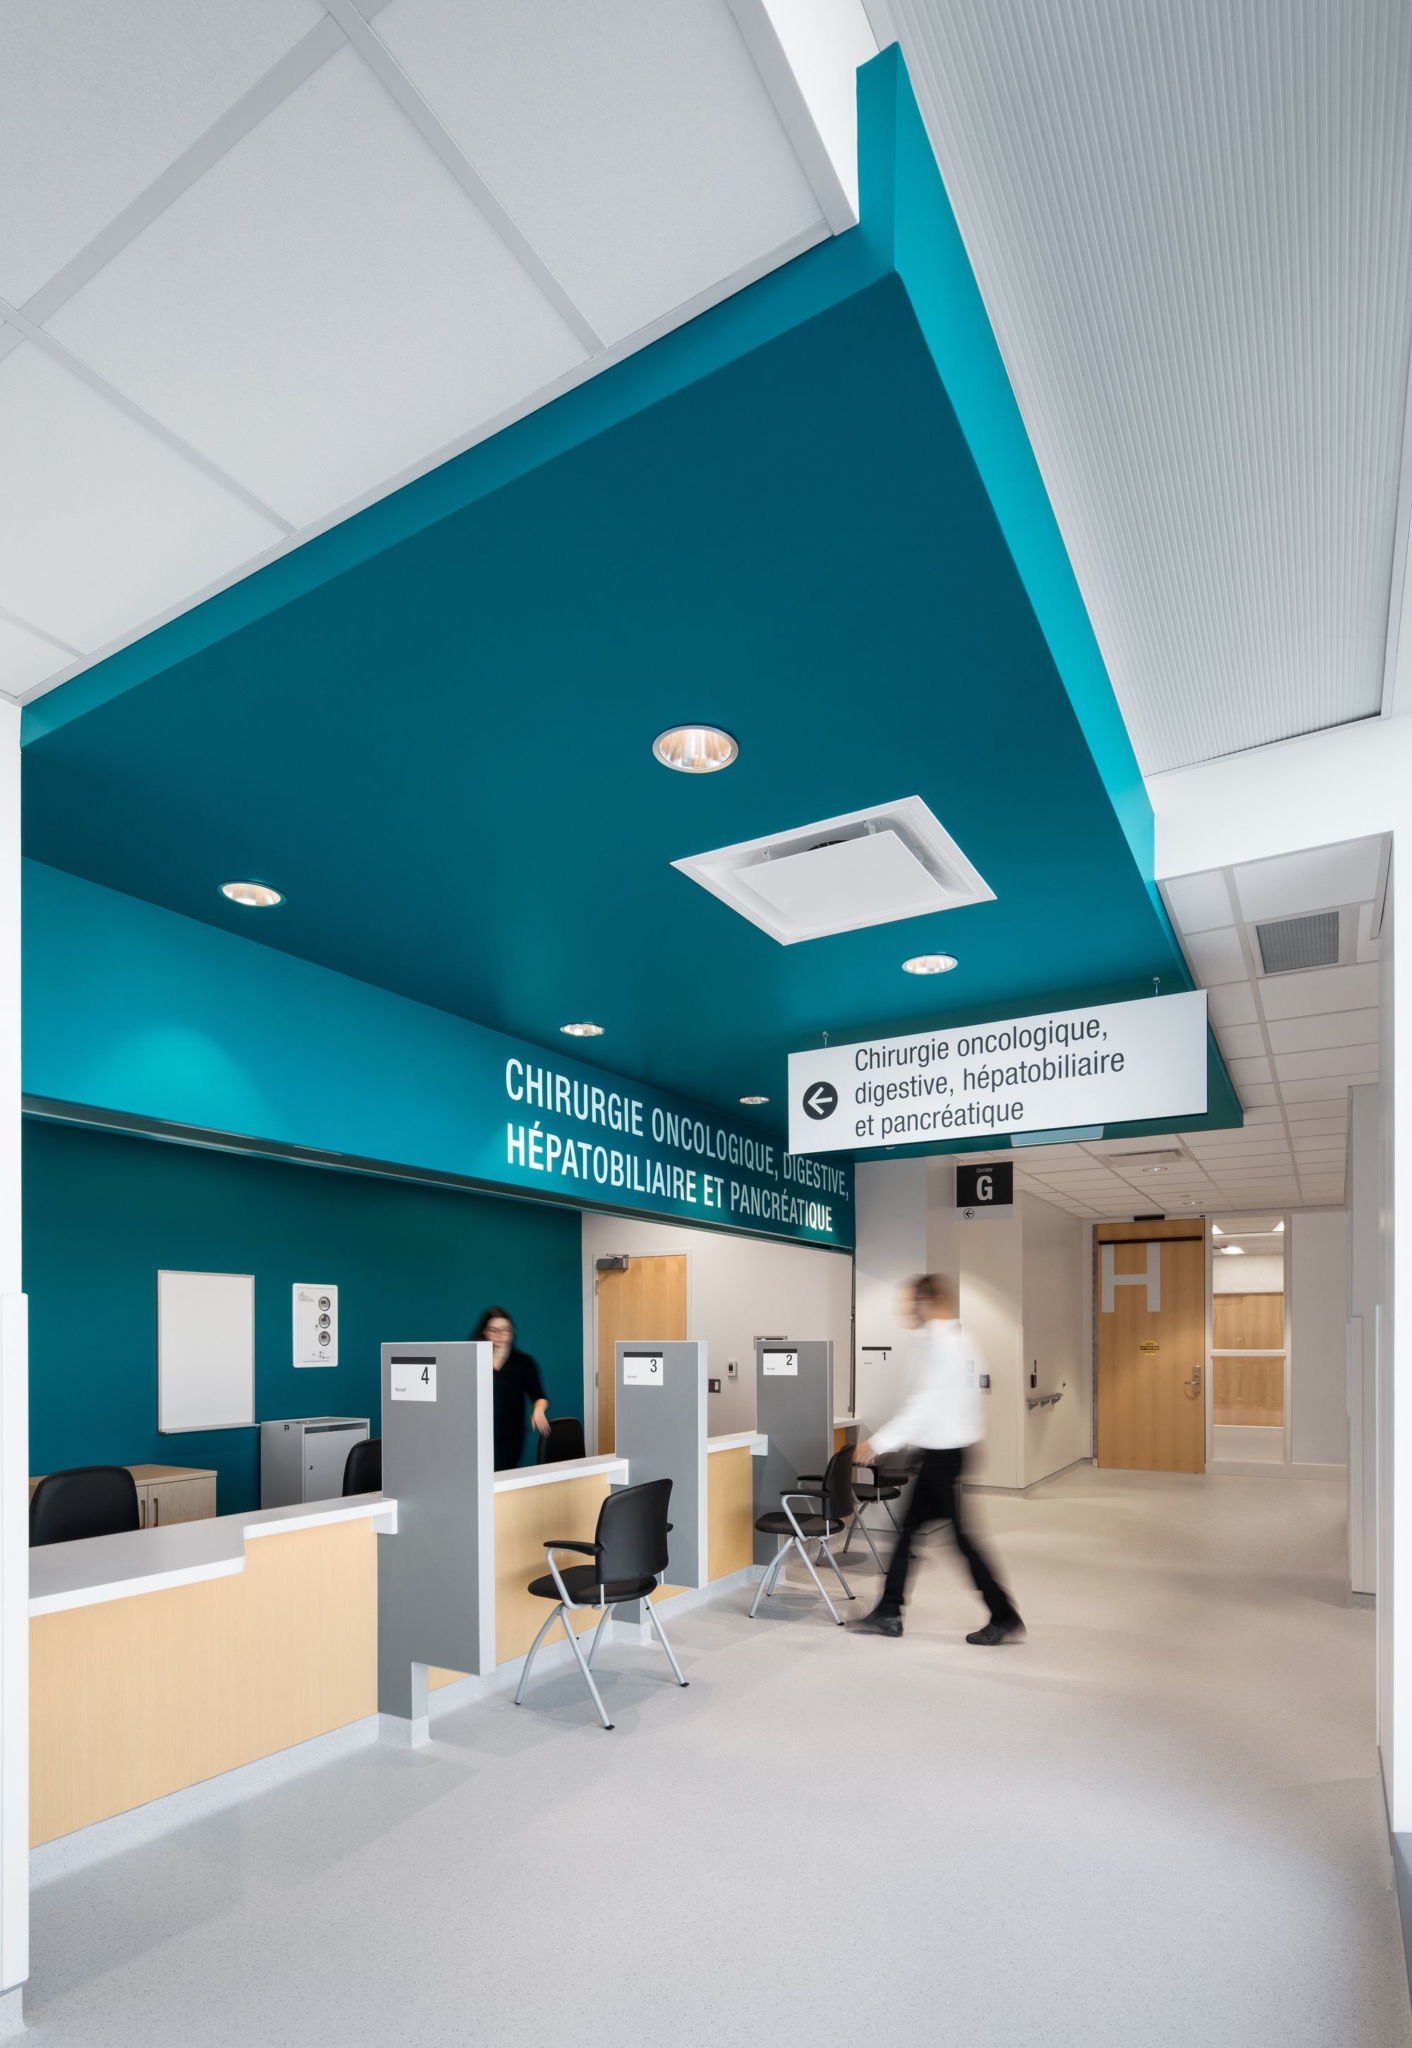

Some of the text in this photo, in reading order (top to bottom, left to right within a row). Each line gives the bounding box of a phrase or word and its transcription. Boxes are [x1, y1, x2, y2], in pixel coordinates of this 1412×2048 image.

[855, 1018, 1108, 1071] Chirurgie oncologique,
[855, 1051, 1125, 1106] digestive, hépatobiliaire
[505, 1058, 849, 1201] CHIRURGIE ONCOLOGIQUE, DIGESTIVE,
[855, 1100, 1024, 1139] et pancréatique
[506, 1121, 833, 1232] HÉPATOBILIAIRE ET PANCRÉATIQUE
[976, 1175, 993, 1201] G
[1101, 1242, 1161, 1313] H
[421, 1366, 430, 1385] 4
[650, 1359, 658, 1373] 3
[786, 1354, 793, 1366] 2
[882, 1351, 886, 1361] 1
